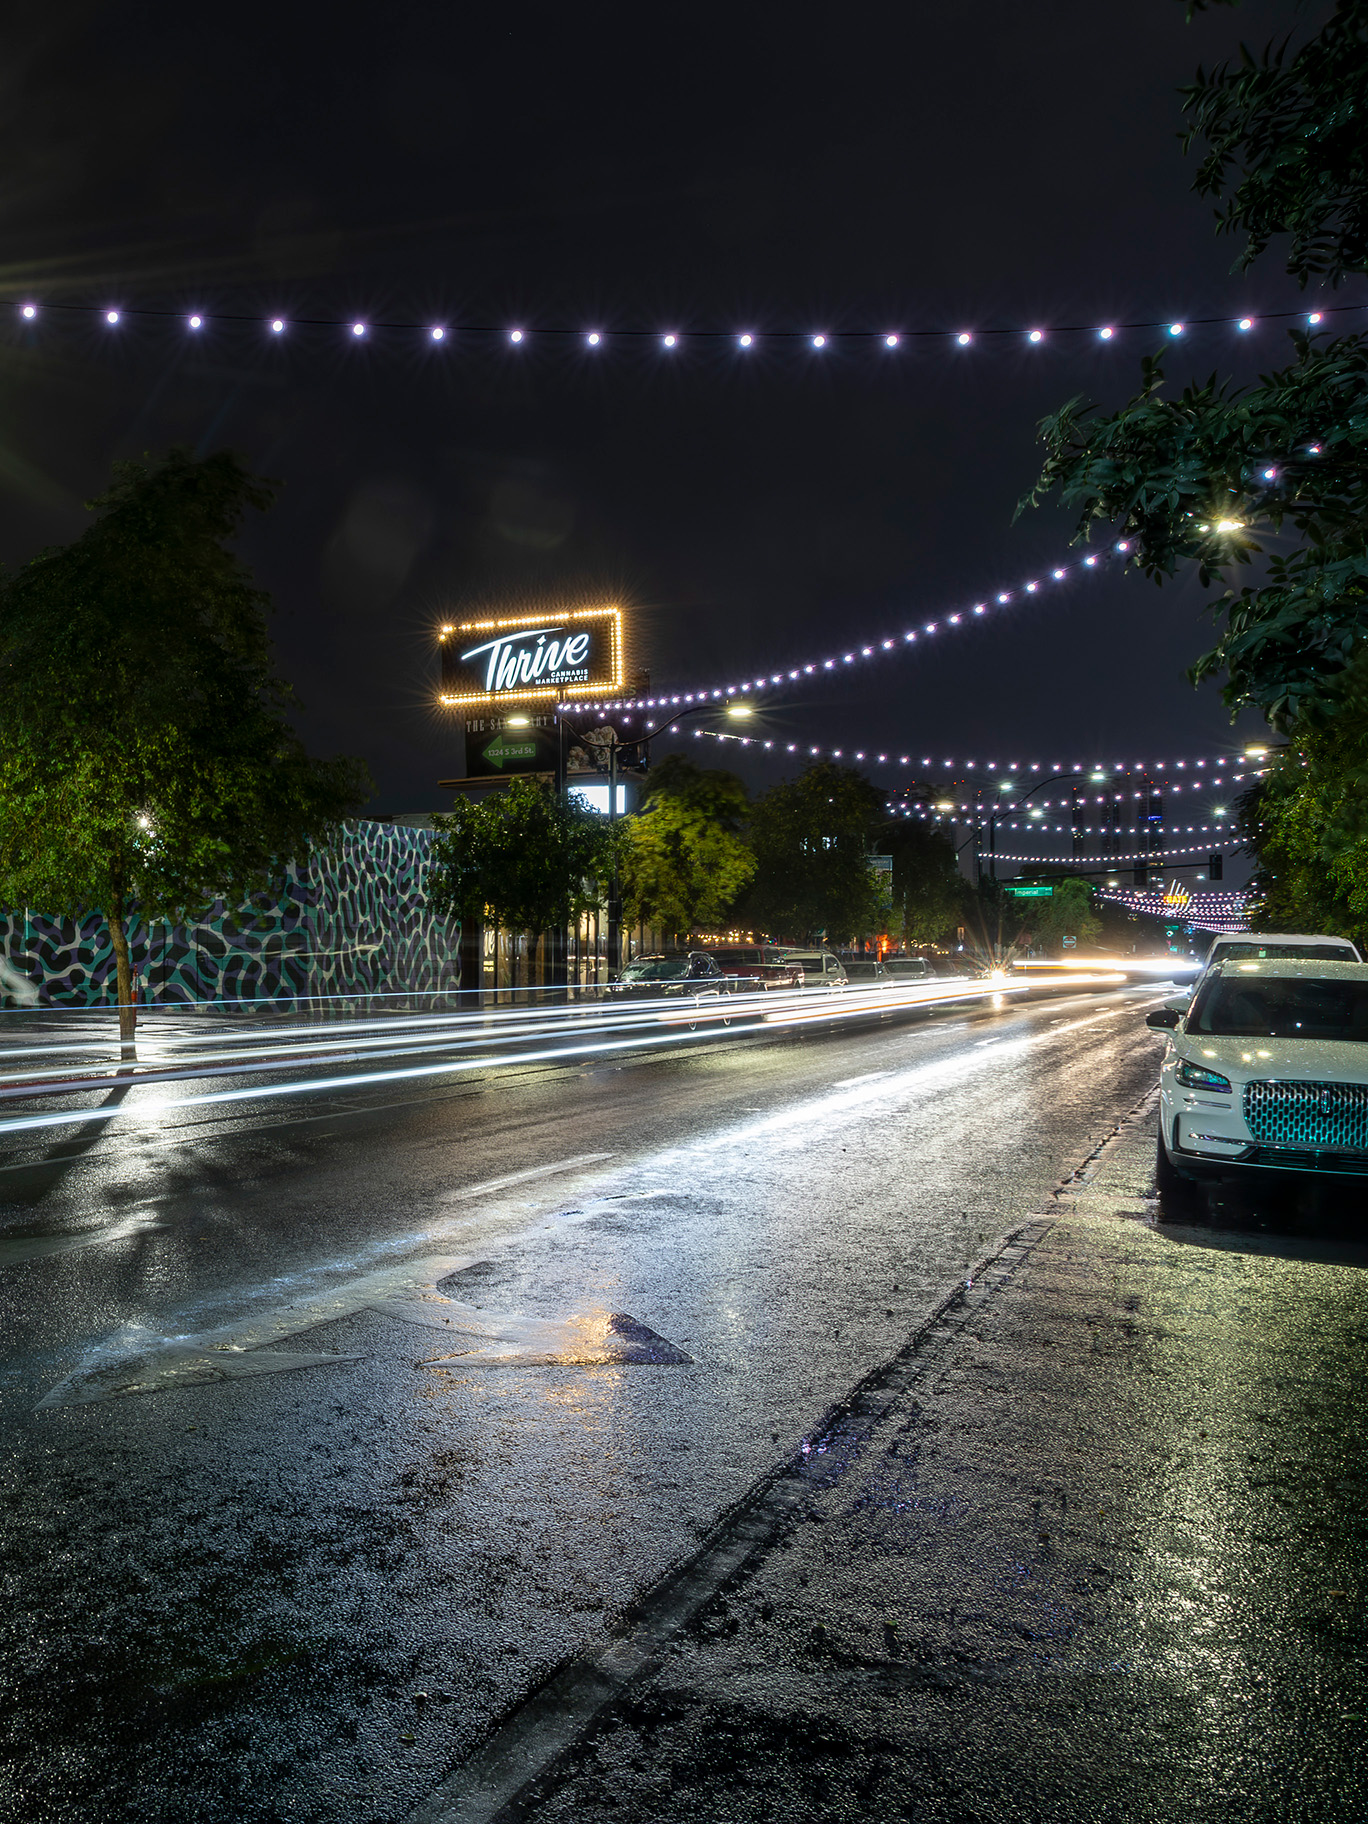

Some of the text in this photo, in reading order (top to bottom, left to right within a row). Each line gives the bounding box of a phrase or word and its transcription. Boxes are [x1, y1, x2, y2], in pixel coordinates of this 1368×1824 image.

[461, 627, 589, 691] Thrive
[551, 668, 589, 678] CANNABIS
[535, 675, 589, 685] MARKETPLACE
[466, 716, 548, 733] THE SANARY
[488, 749, 504, 757] 1324
[511, 747, 524, 755] 3rd
[524, 746, 535, 754] St.
[1014, 888, 1039, 896] Imperial
